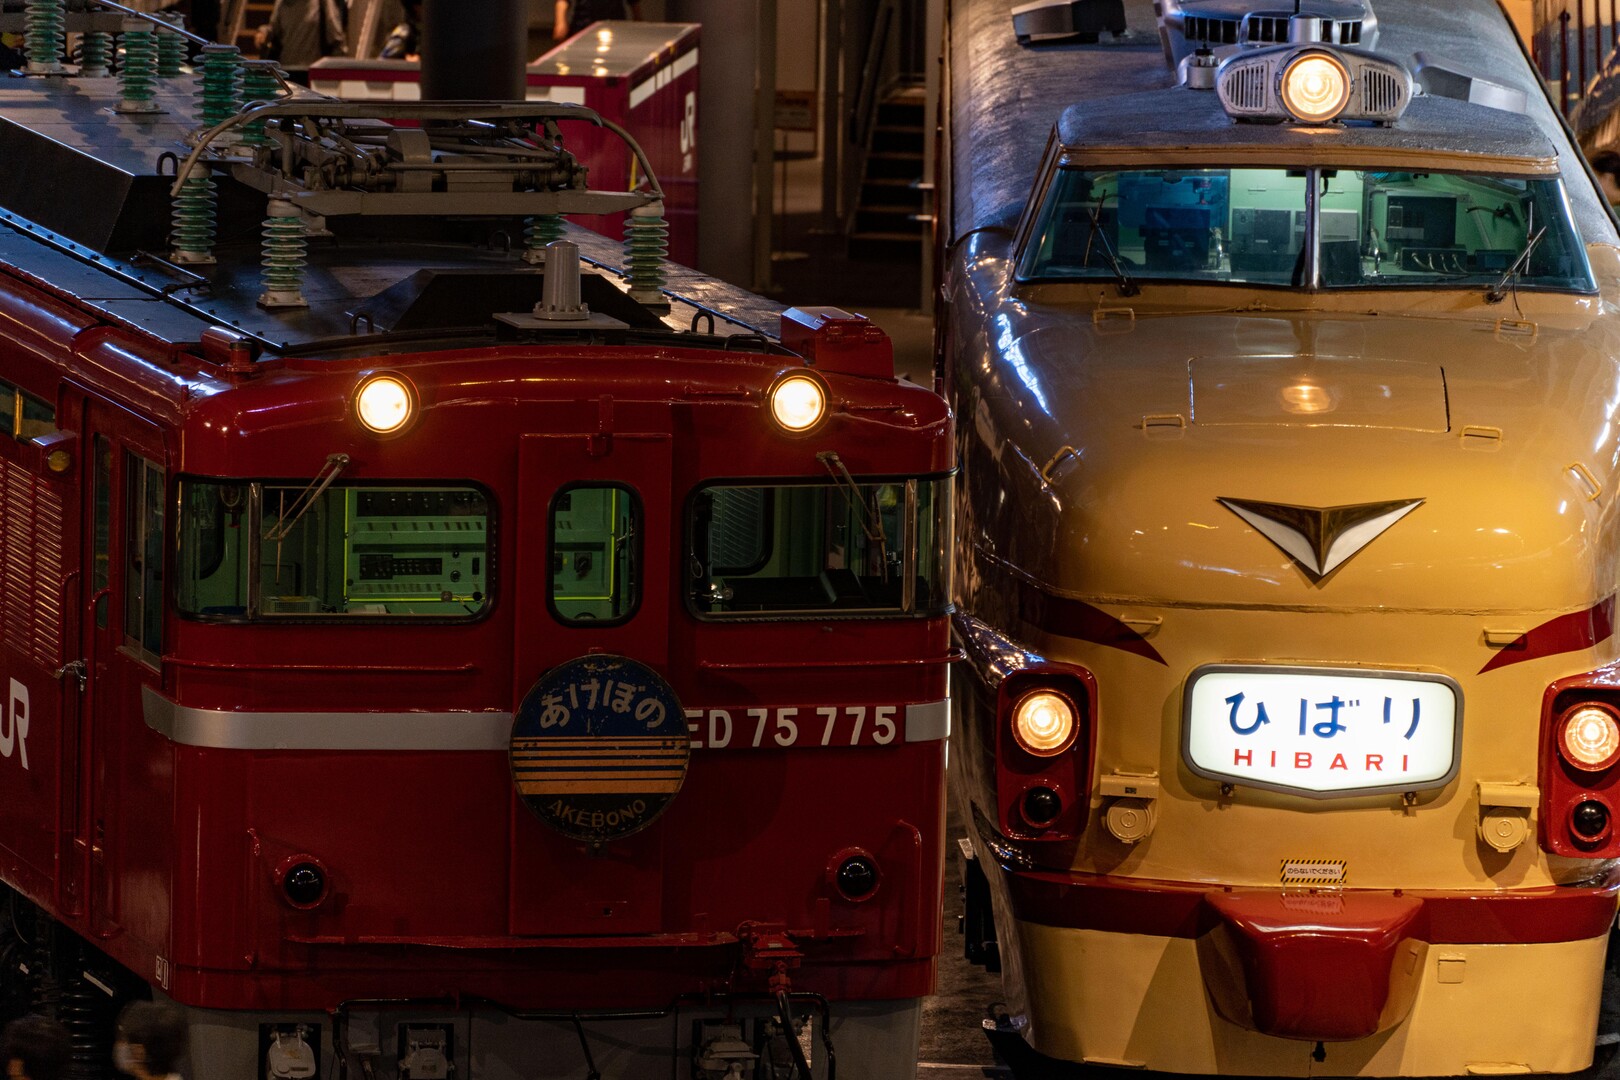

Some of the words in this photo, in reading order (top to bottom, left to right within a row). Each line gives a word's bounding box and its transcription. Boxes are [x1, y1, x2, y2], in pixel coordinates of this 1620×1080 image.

[680, 91, 696, 154] JR
[540, 678, 666, 729] あけぼの
[1225, 691, 1420, 740] ひばり
[747, 708, 798, 747] 75
[816, 706, 896, 745] 775
[1234, 748, 1409, 772] HIBARI
[547, 799, 646, 828] AKEBONO
[1287, 867, 1341, 875] のらないでください
